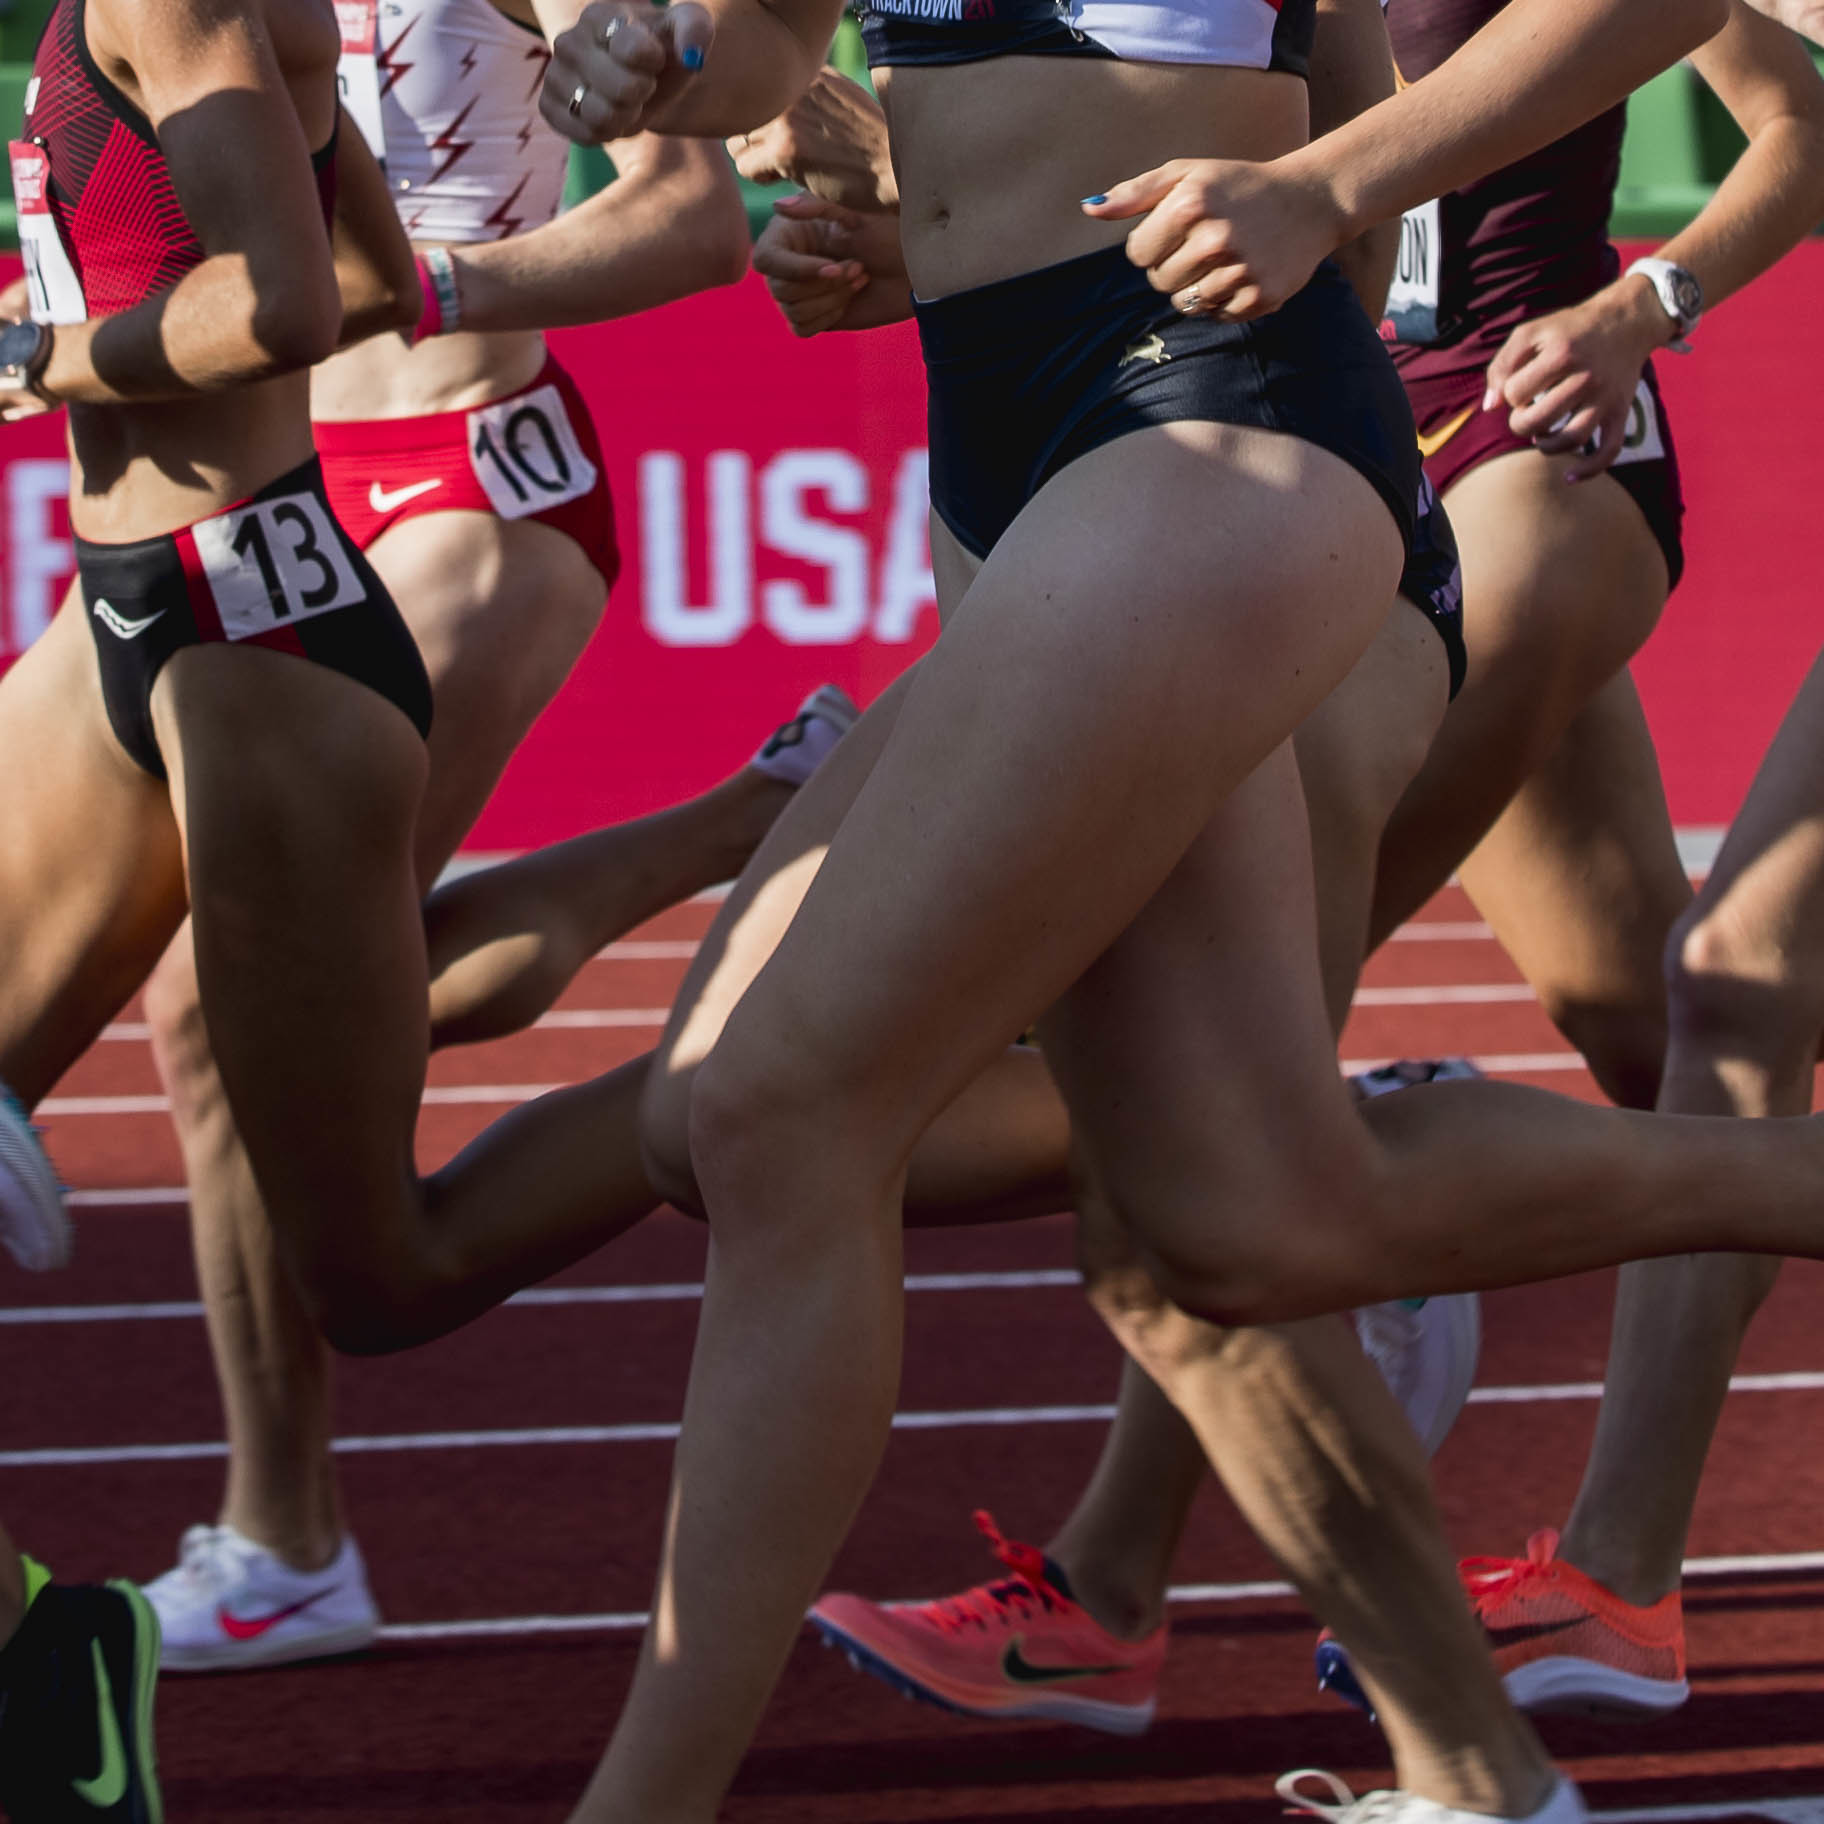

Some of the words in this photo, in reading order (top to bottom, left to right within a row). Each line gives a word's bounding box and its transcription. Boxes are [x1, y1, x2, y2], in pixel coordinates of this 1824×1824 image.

[1398, 216, 1428, 286] ON
[475, 406, 571, 503] 10
[231, 502, 340, 620] 13
